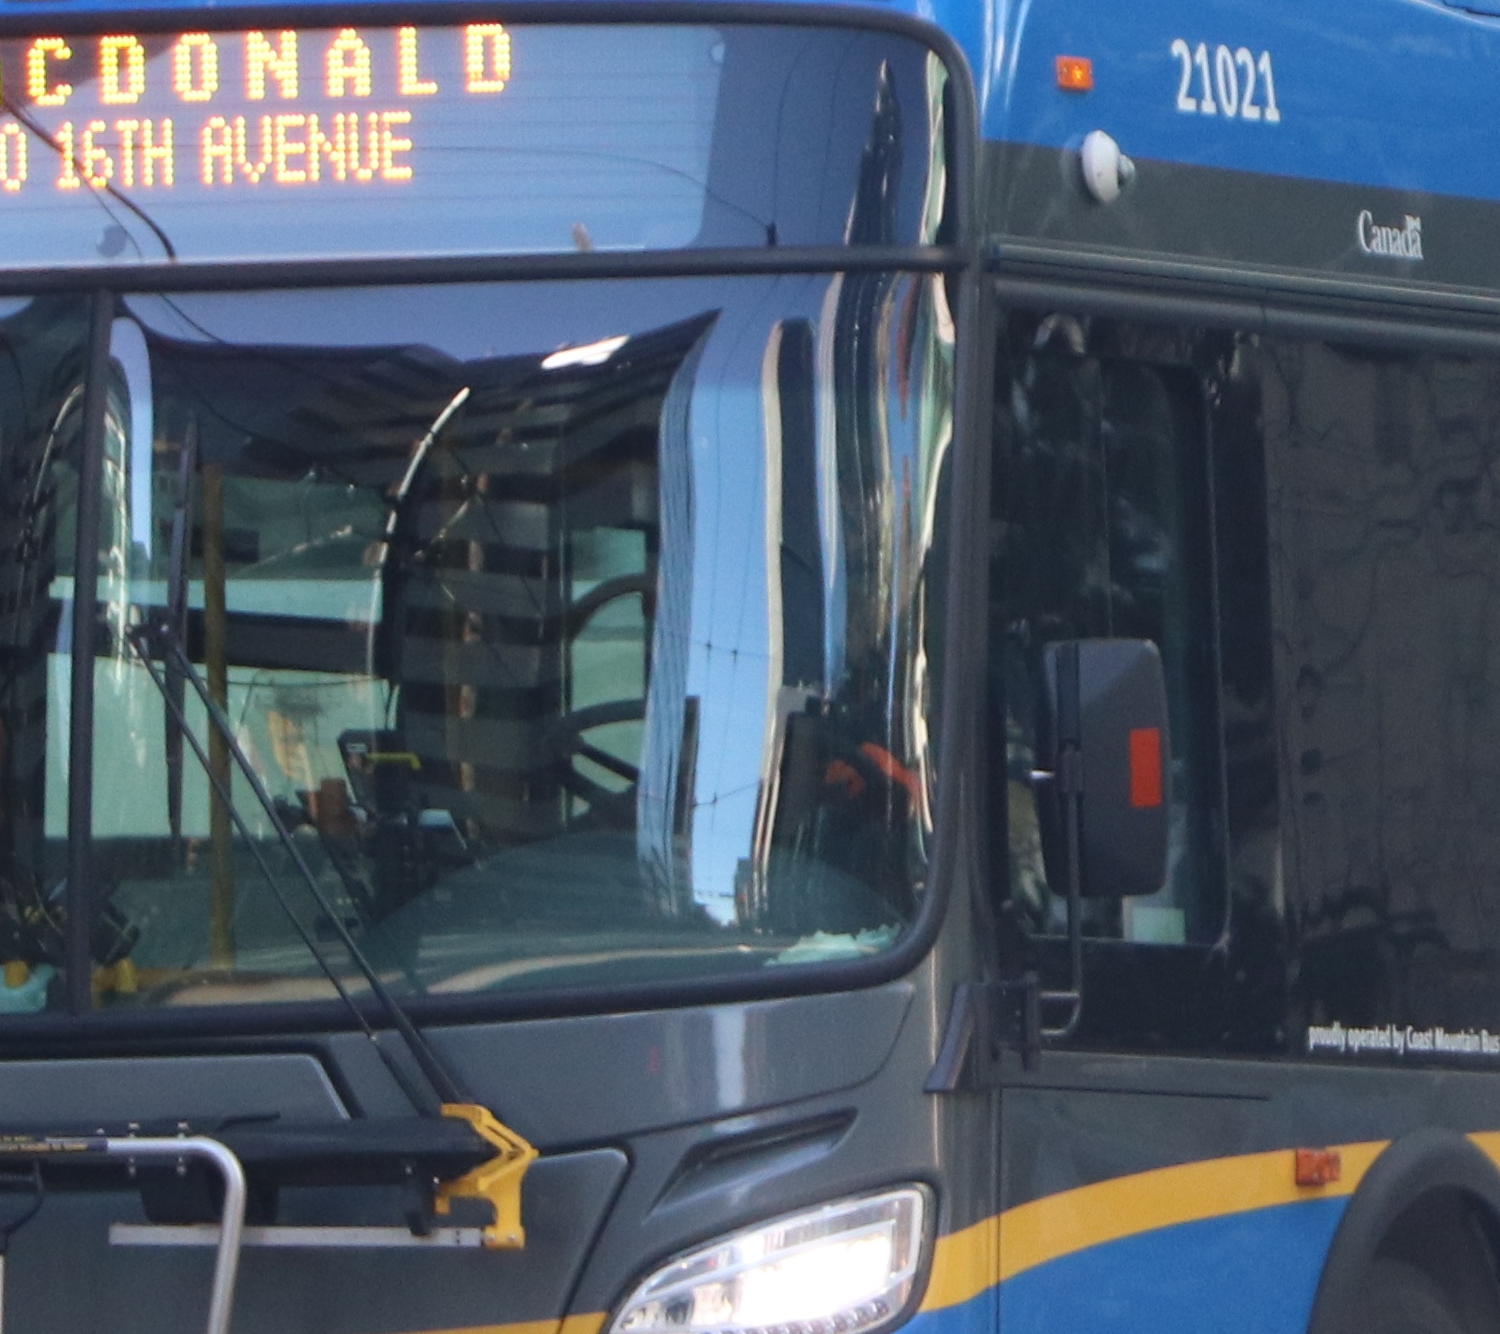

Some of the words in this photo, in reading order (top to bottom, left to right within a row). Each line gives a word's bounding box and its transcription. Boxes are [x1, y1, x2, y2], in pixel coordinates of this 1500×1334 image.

[1170, 38, 1281, 122] 21021
[56, 115, 175, 191] 16TH
[199, 109, 414, 185] AVENUE
[1358, 209, 1424, 259] Canada
[1308, 1020, 1346, 1053] proudly
[1347, 1024, 1390, 1053] operated
[1392, 1023, 1405, 1056] by
[1406, 1025, 1433, 1050] Coast
[1434, 1027, 1480, 1052] Mountain
[1481, 1028, 1500, 1054] Bus
